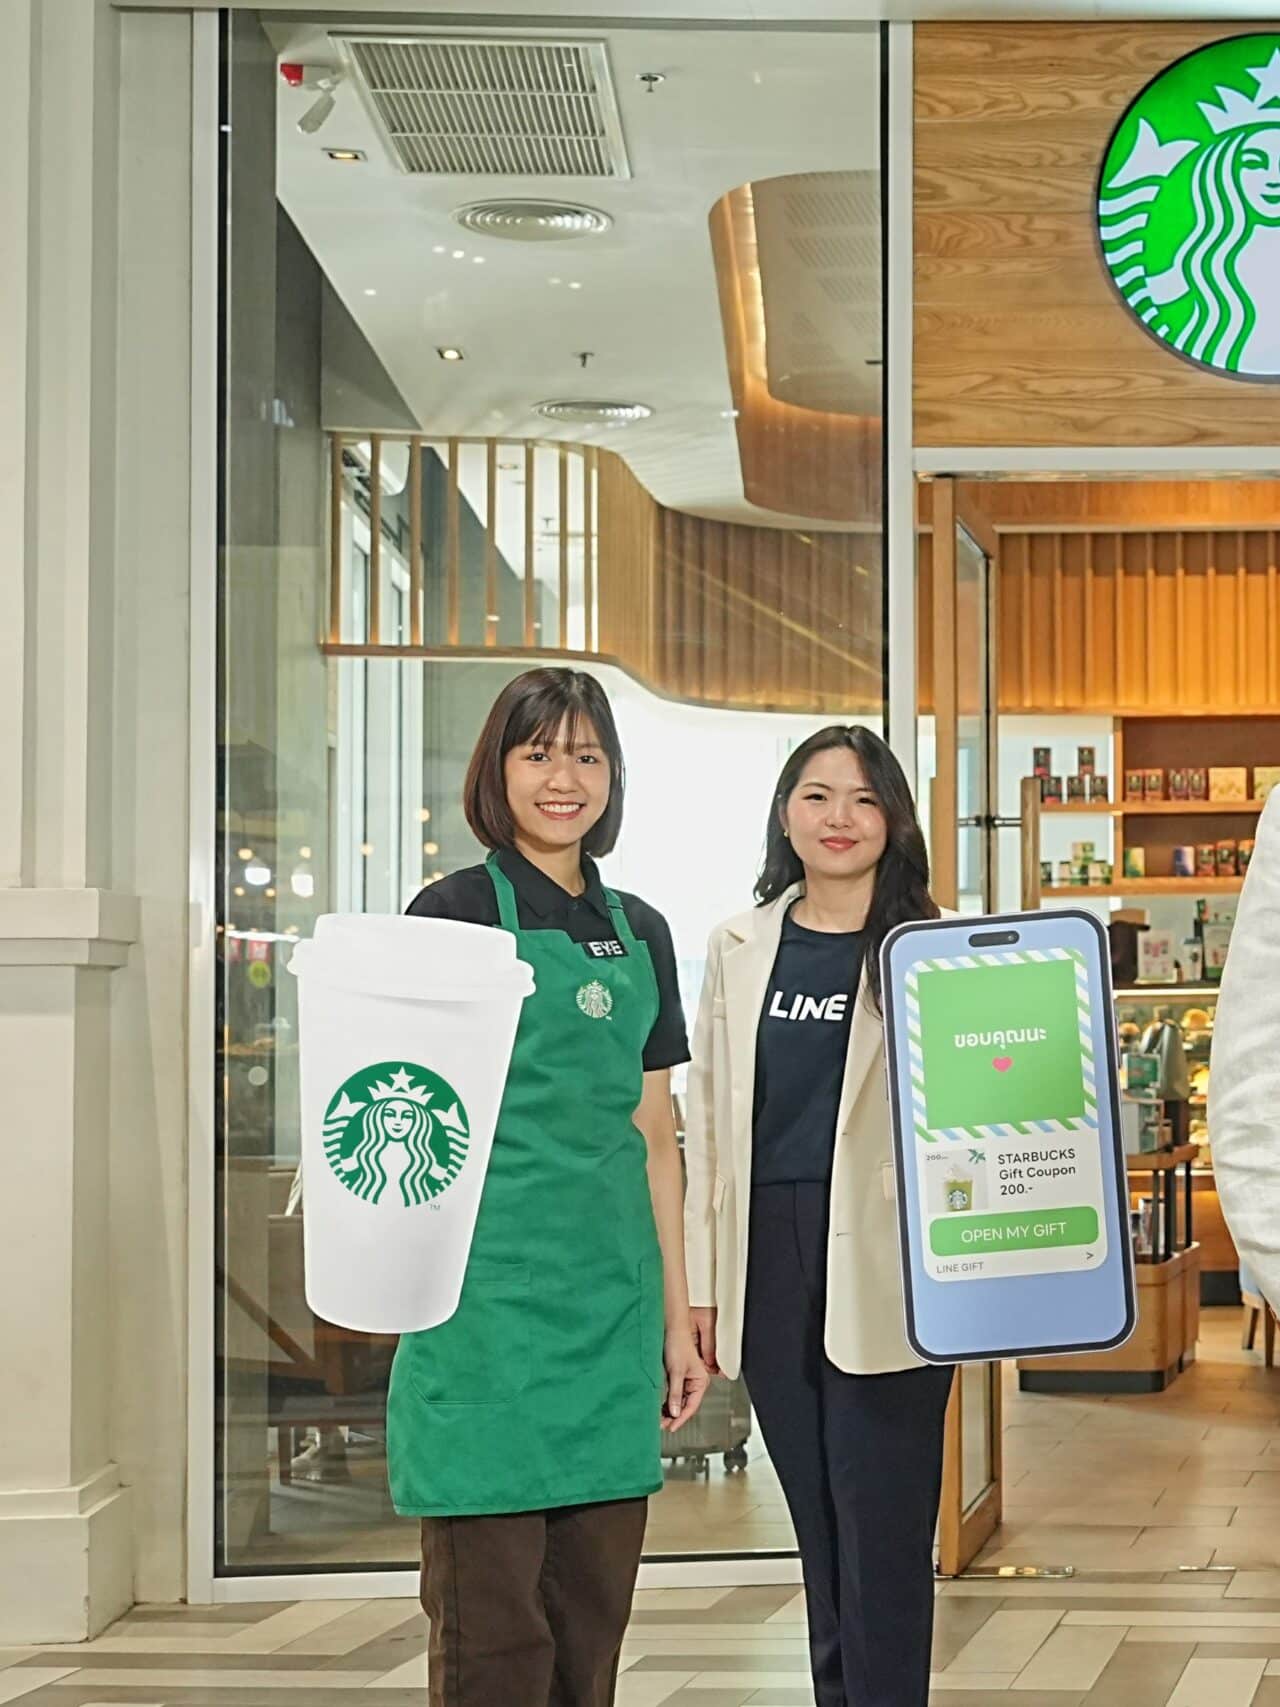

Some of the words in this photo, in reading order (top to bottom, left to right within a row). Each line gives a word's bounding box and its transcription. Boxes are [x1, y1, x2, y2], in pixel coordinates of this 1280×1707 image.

[587, 940, 624, 957] EYE
[768, 990, 849, 1021] LINE
[953, 1027, 1048, 1050] ขอบคุณนะ
[997, 1147, 1076, 1165] STARBUCKS
[999, 1167, 1024, 1180] Gift
[1026, 1165, 1076, 1178] Coupon
[1000, 1183, 1033, 1196] 200.-
[961, 1228, 1003, 1243] OPEN
[1006, 1224, 1031, 1239] MY
[1033, 1221, 1067, 1238] GIFT
[936, 1263, 960, 1274] LINE
[961, 1261, 984, 1272] GIFT
